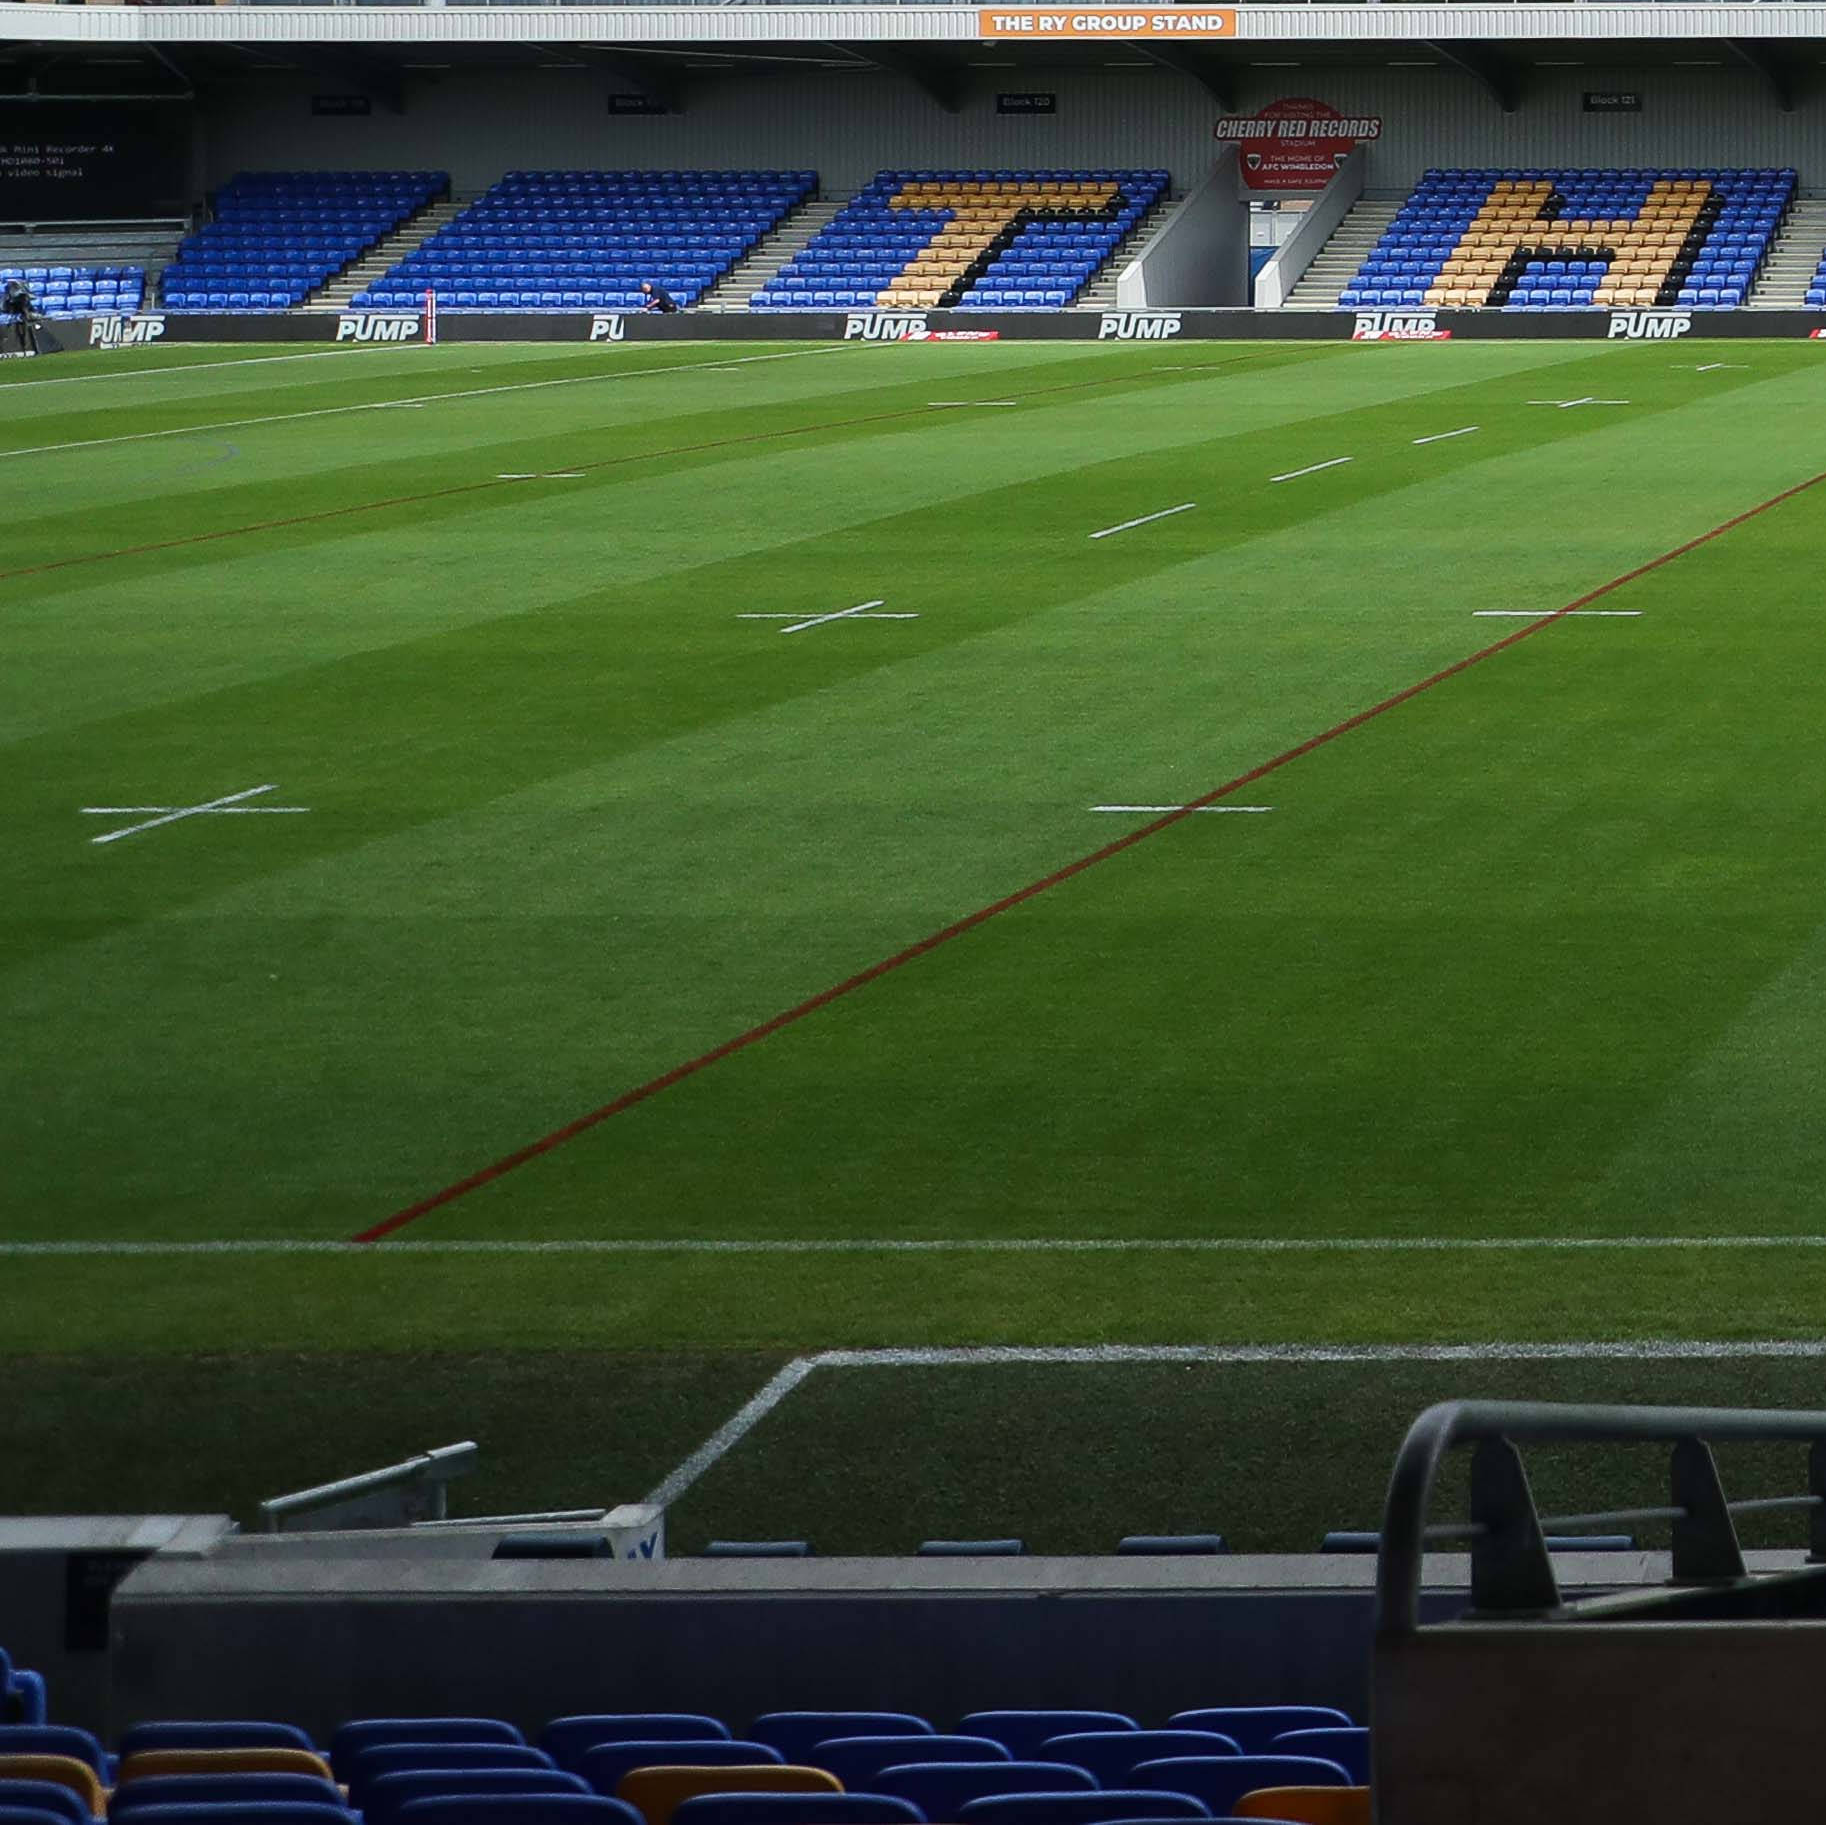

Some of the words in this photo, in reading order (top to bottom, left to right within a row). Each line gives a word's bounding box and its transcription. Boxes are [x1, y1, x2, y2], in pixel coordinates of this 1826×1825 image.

[992, 16, 1033, 30] THE
[1039, 16, 1067, 30] RY
[1071, 15, 1147, 31] GROUP
[1151, 15, 1223, 31] STAND
[1003, 97, 1031, 106] Block
[1216, 119, 1277, 137] CHERRY
[1278, 119, 1307, 137] RED
[1309, 119, 1379, 137] RECORDS
[1281, 163, 1334, 171] WIMBLEDON
[336, 315, 419, 341] PUMP
[844, 314, 927, 339] PUMP
[1098, 313, 1181, 339] PUMP
[1353, 313, 1436, 338] PUMP
[1608, 312, 1691, 338] PUMP
